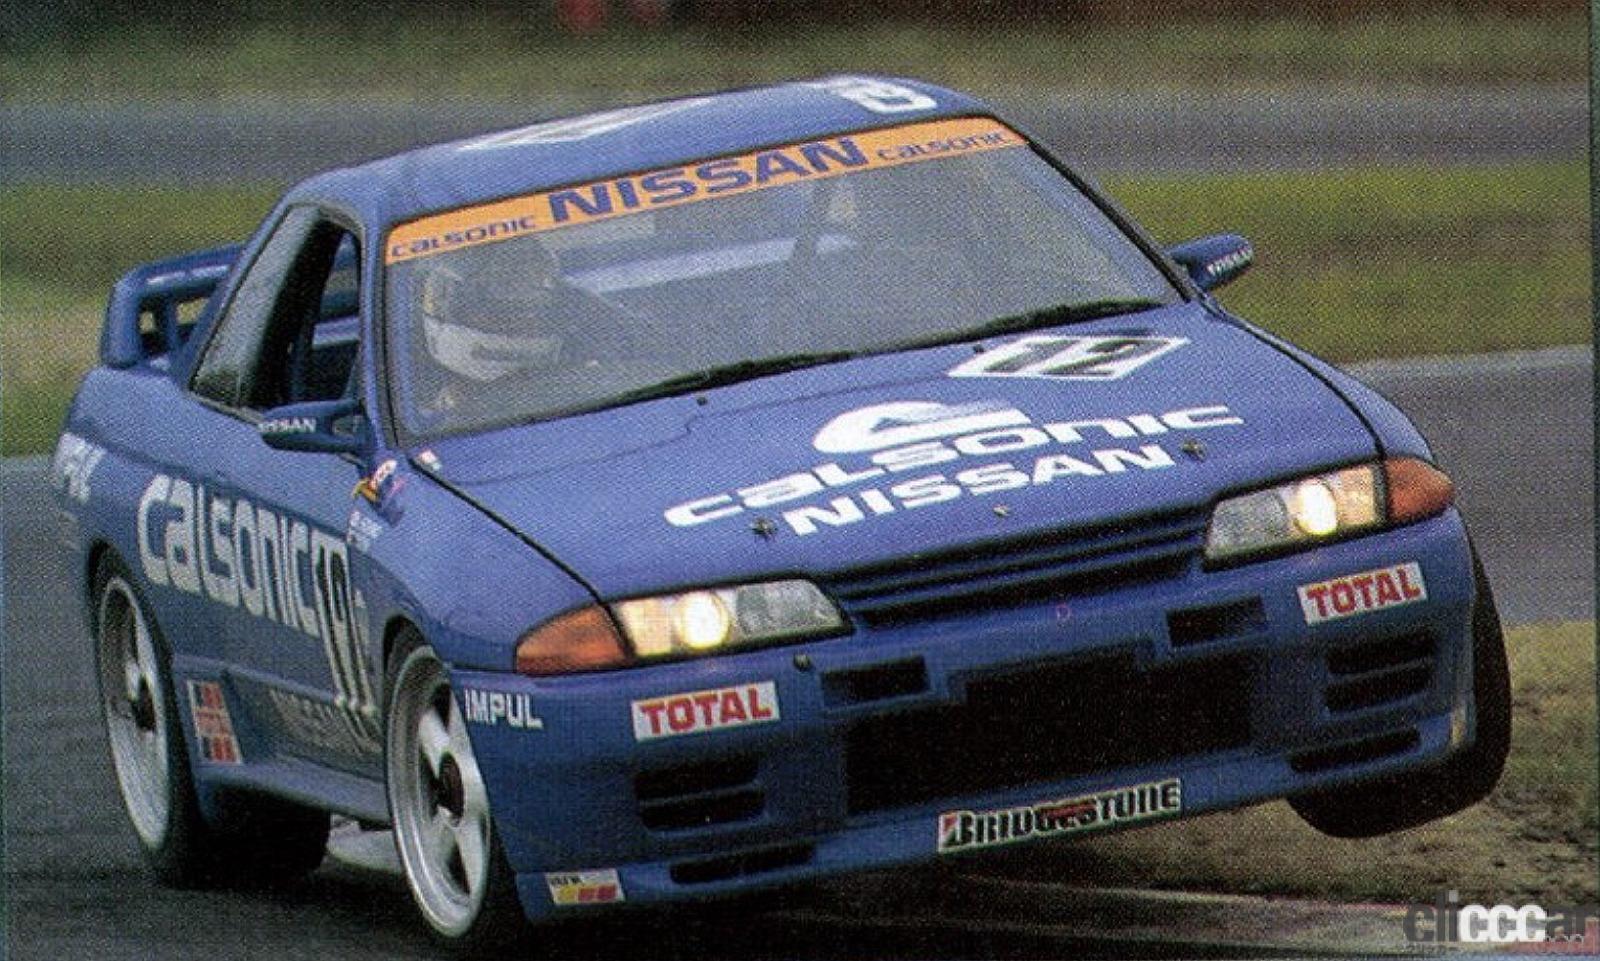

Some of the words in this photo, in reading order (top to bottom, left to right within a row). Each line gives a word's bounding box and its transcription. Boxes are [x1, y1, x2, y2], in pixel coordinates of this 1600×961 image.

[548, 137, 868, 223] NISSAN
[782, 442, 1177, 536] NISSAN
[1306, 567, 1421, 617] TOTAL
[464, 688, 544, 729] IMPUL
[640, 687, 773, 736] TOTAL
